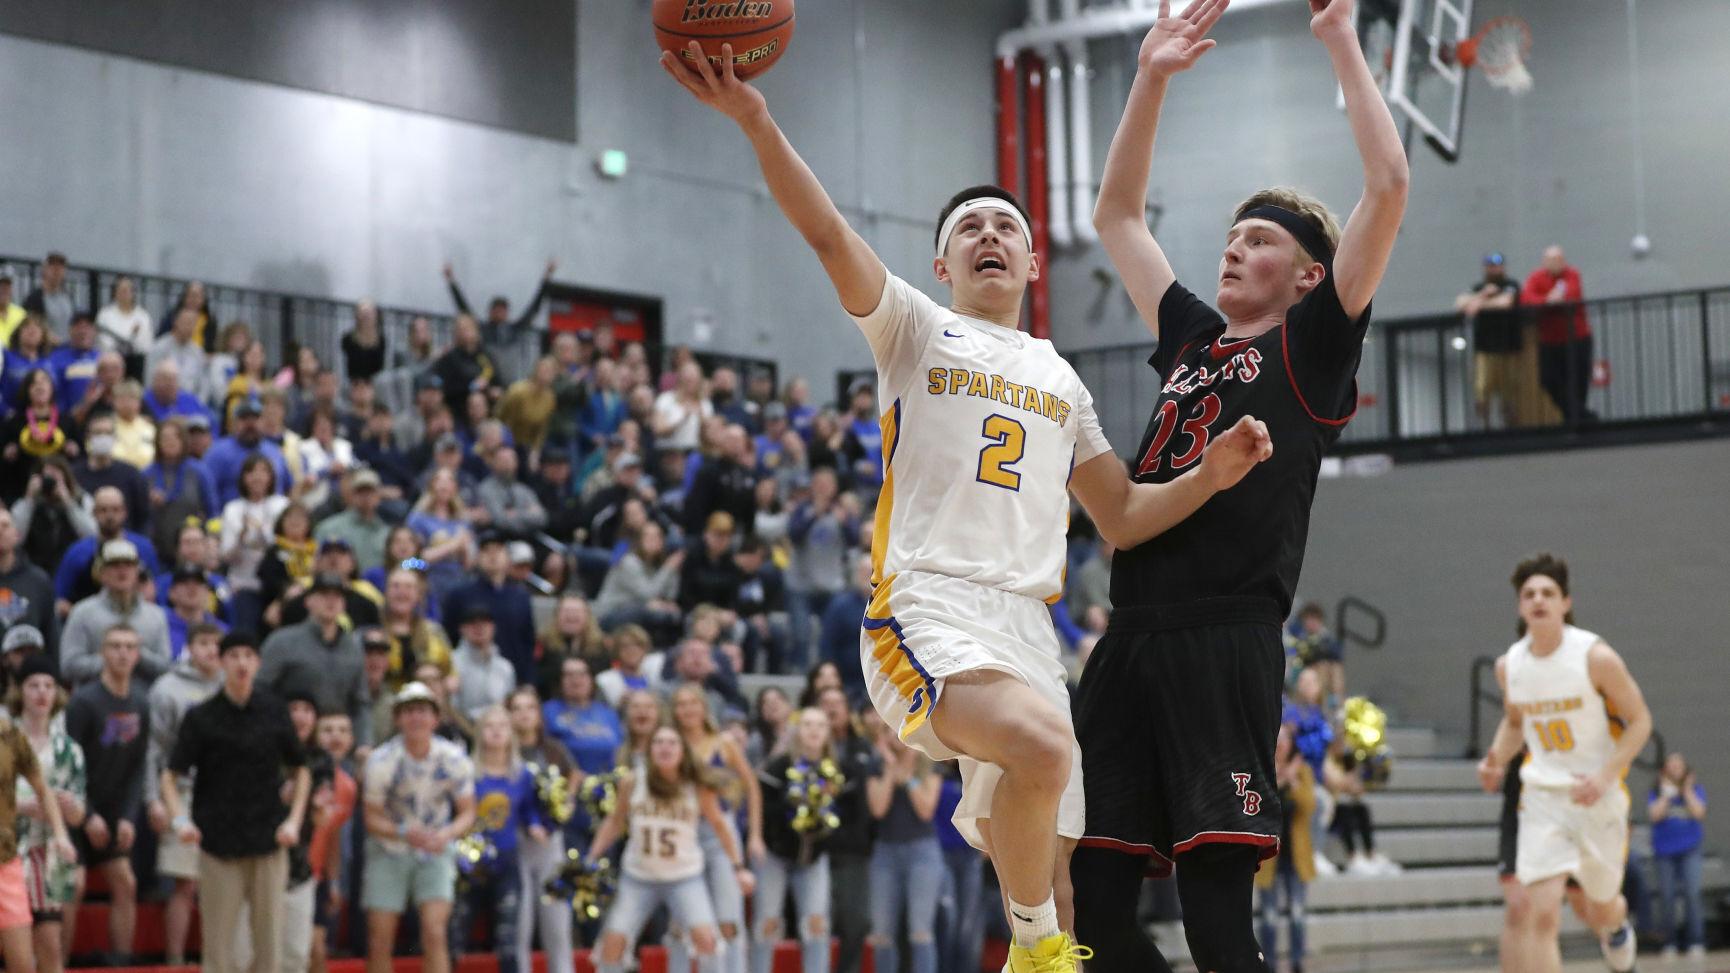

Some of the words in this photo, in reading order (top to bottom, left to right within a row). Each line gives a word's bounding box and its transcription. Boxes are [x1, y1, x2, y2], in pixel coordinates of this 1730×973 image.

[681, 0, 773, 23] Baden
[751, 40, 778, 62] PRO
[928, 367, 1072, 428] SPARTANS
[1135, 392, 1222, 478] 23
[976, 413, 1026, 492] 2
[1533, 719, 1576, 752] 10
[641, 826, 677, 858] 15
